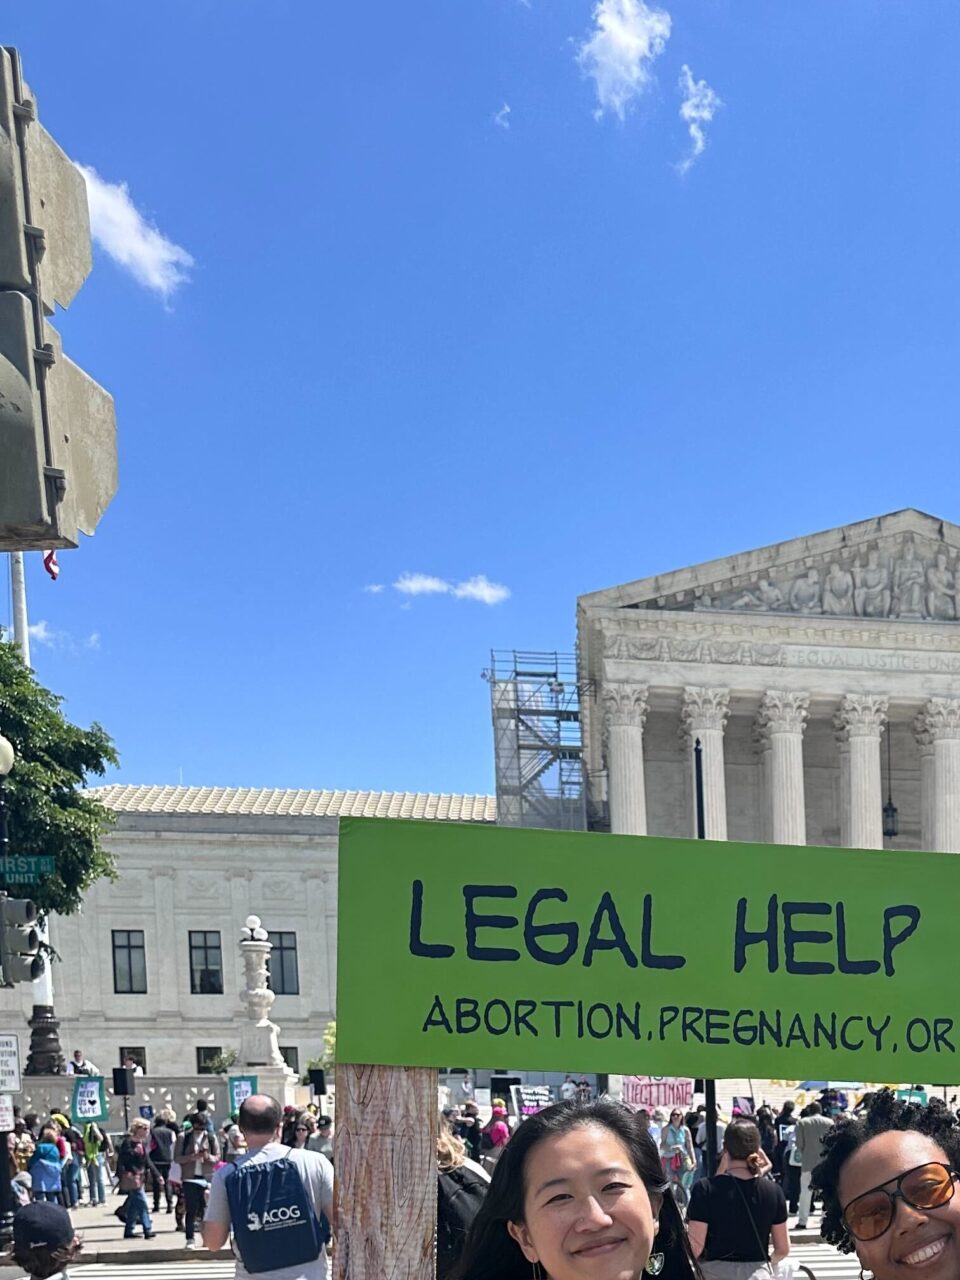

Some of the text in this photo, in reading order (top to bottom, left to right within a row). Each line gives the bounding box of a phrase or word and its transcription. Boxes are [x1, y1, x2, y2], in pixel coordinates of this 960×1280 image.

[799, 651, 852, 667] EQUAL
[856, 653, 921, 670] JUSTICE
[5, 873, 36, 884] UNIT
[407, 878, 688, 972] LEGAL
[732, 892, 922, 979] HELP
[905, 1016, 957, 1054] OR
[262, 1205, 301, 1225] ACOG
